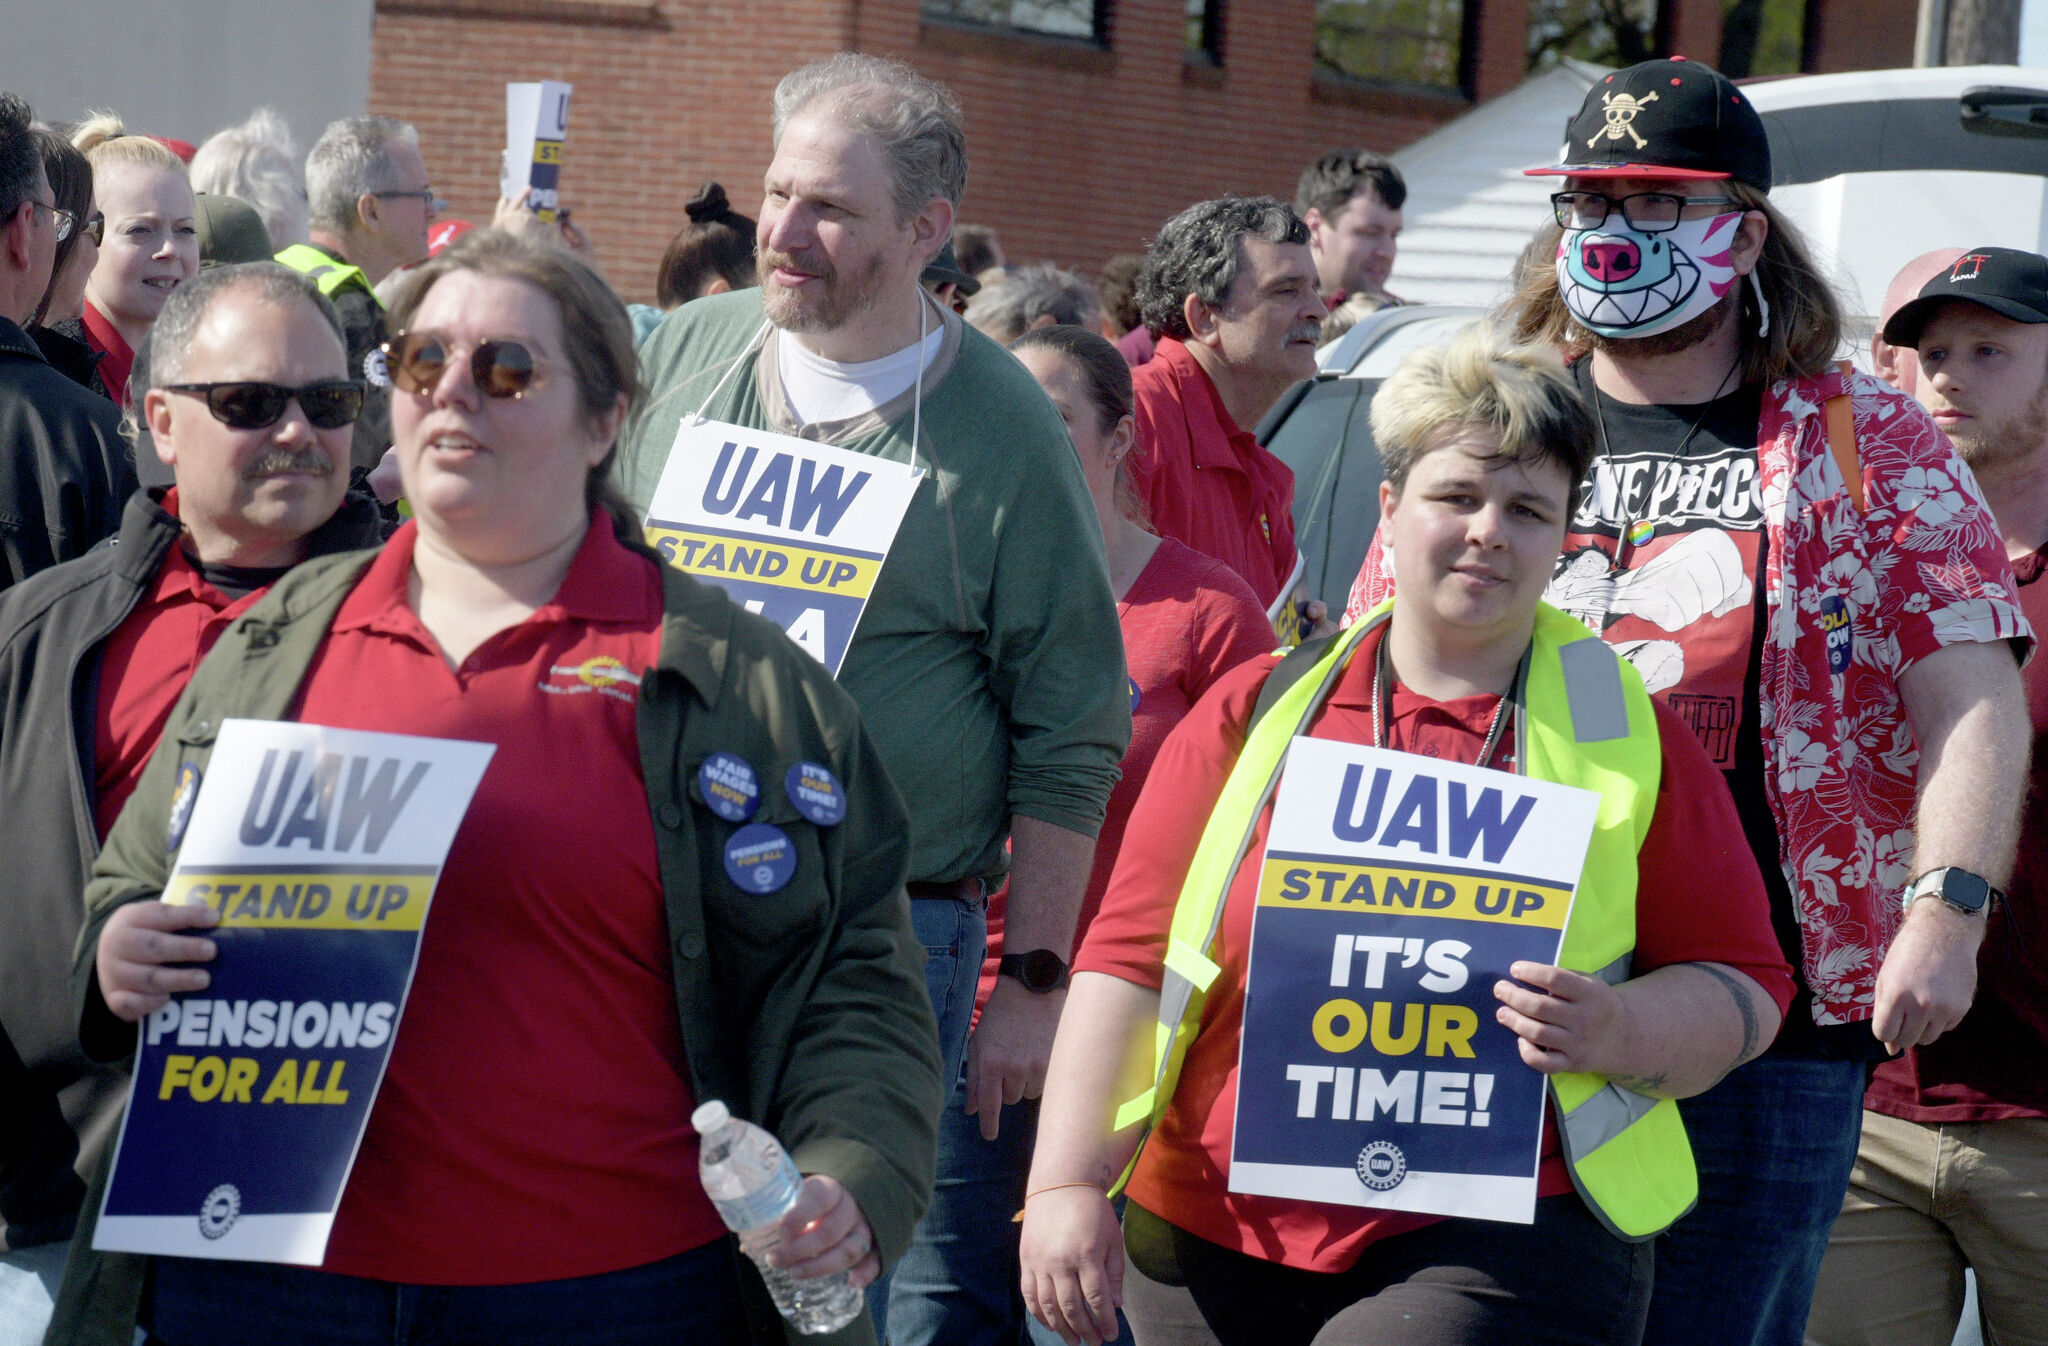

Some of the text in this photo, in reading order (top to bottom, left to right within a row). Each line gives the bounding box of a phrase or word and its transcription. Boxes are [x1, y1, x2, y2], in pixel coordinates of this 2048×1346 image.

[1950, 272, 1978, 283] JAPAN
[702, 441, 873, 537] UAW
[1579, 460, 1651, 520] NE
[655, 536, 858, 588] STAND UP
[705, 764, 758, 798] WAGES
[710, 781, 747, 806] NOW
[716, 757, 751, 781] FAIR
[801, 764, 830, 782] IT'S
[801, 776, 832, 793] OUR
[239, 749, 432, 854] UAW
[1332, 763, 1538, 864] UAW
[763, 850, 784, 862] ALL
[186, 884, 409, 921] STAND UP
[1279, 868, 1545, 918] STAND UP
[1330, 934, 1472, 993] IT'S
[147, 999, 395, 1048] PENSIONS
[1312, 998, 1479, 1058] OUR
[158, 1054, 349, 1104] FOR ALL
[1286, 1064, 1495, 1127] TIME!
[1371, 1158, 1392, 1171] UAW
